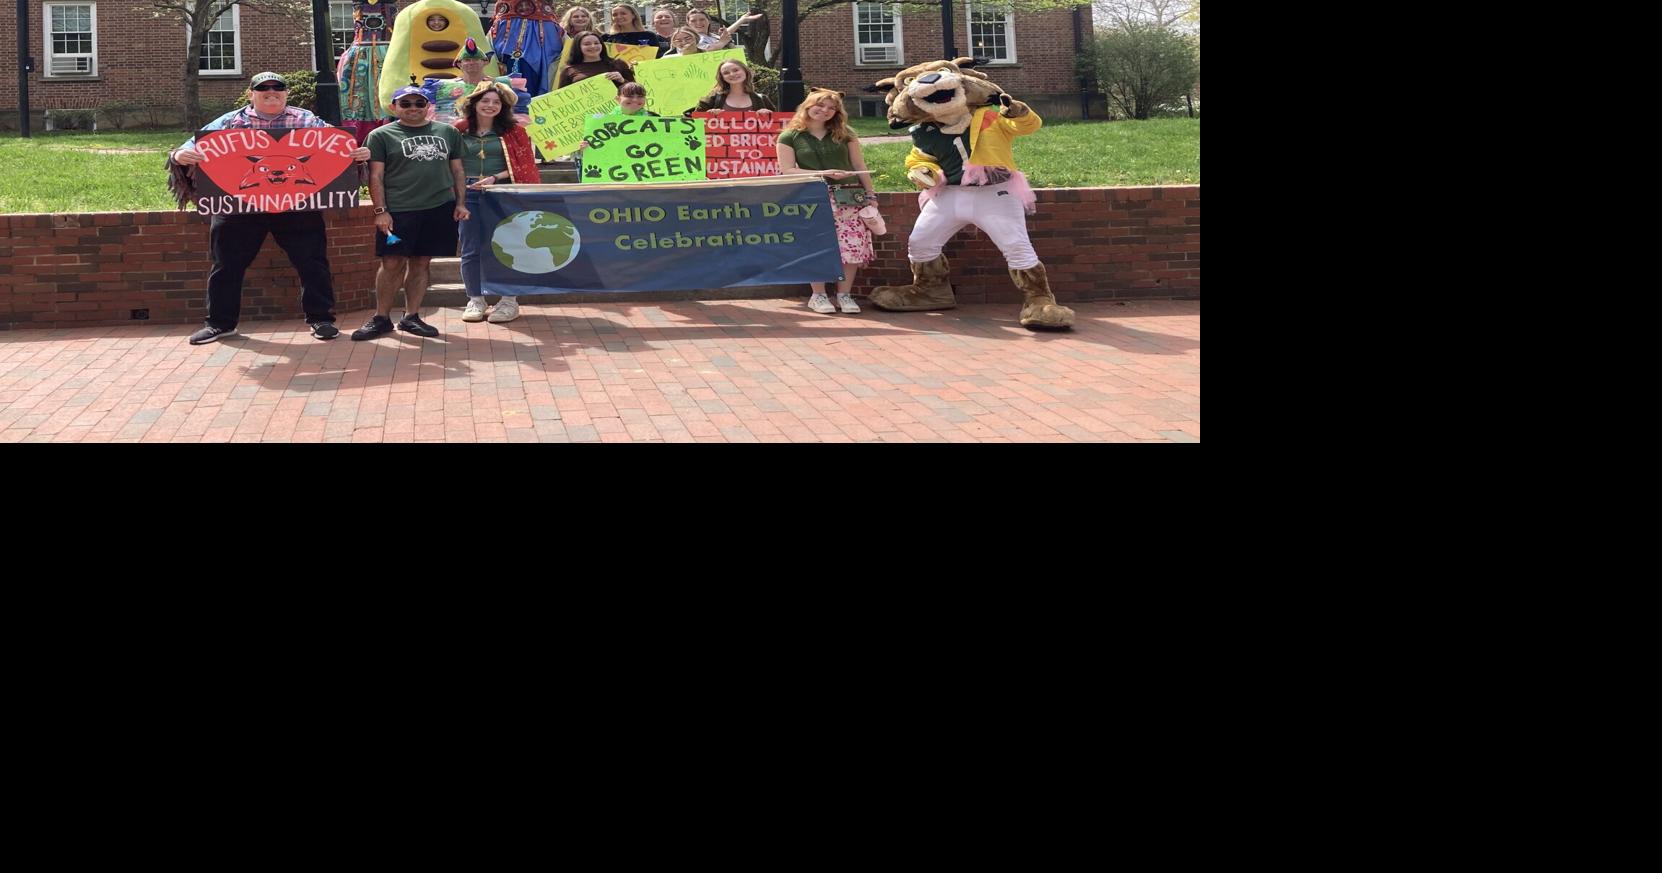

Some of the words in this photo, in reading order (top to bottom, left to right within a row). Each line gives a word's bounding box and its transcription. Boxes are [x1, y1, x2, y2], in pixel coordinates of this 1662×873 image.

[531, 97, 553, 114] ALK
[555, 89, 576, 103] TO
[580, 79, 599, 95] ME
[551, 98, 586, 121] ABOUT
[534, 121, 568, 142] LIMATE
[568, 117, 578, 129] &
[583, 117, 696, 149] BOBCATS
[705, 134, 725, 147] ED
[195, 129, 270, 163] RUFUS
[288, 128, 358, 158] LOVES
[625, 142, 663, 158] GO
[735, 149, 763, 160] TO
[608, 156, 702, 181] GREEN
[706, 160, 780, 175] USTAINAB
[198, 189, 358, 216] SUSTAINABILITY
[588, 206, 667, 224] OHIO
[676, 202, 751, 221] Earth
[761, 201, 819, 220] Day
[614, 229, 796, 251] Celebrations
